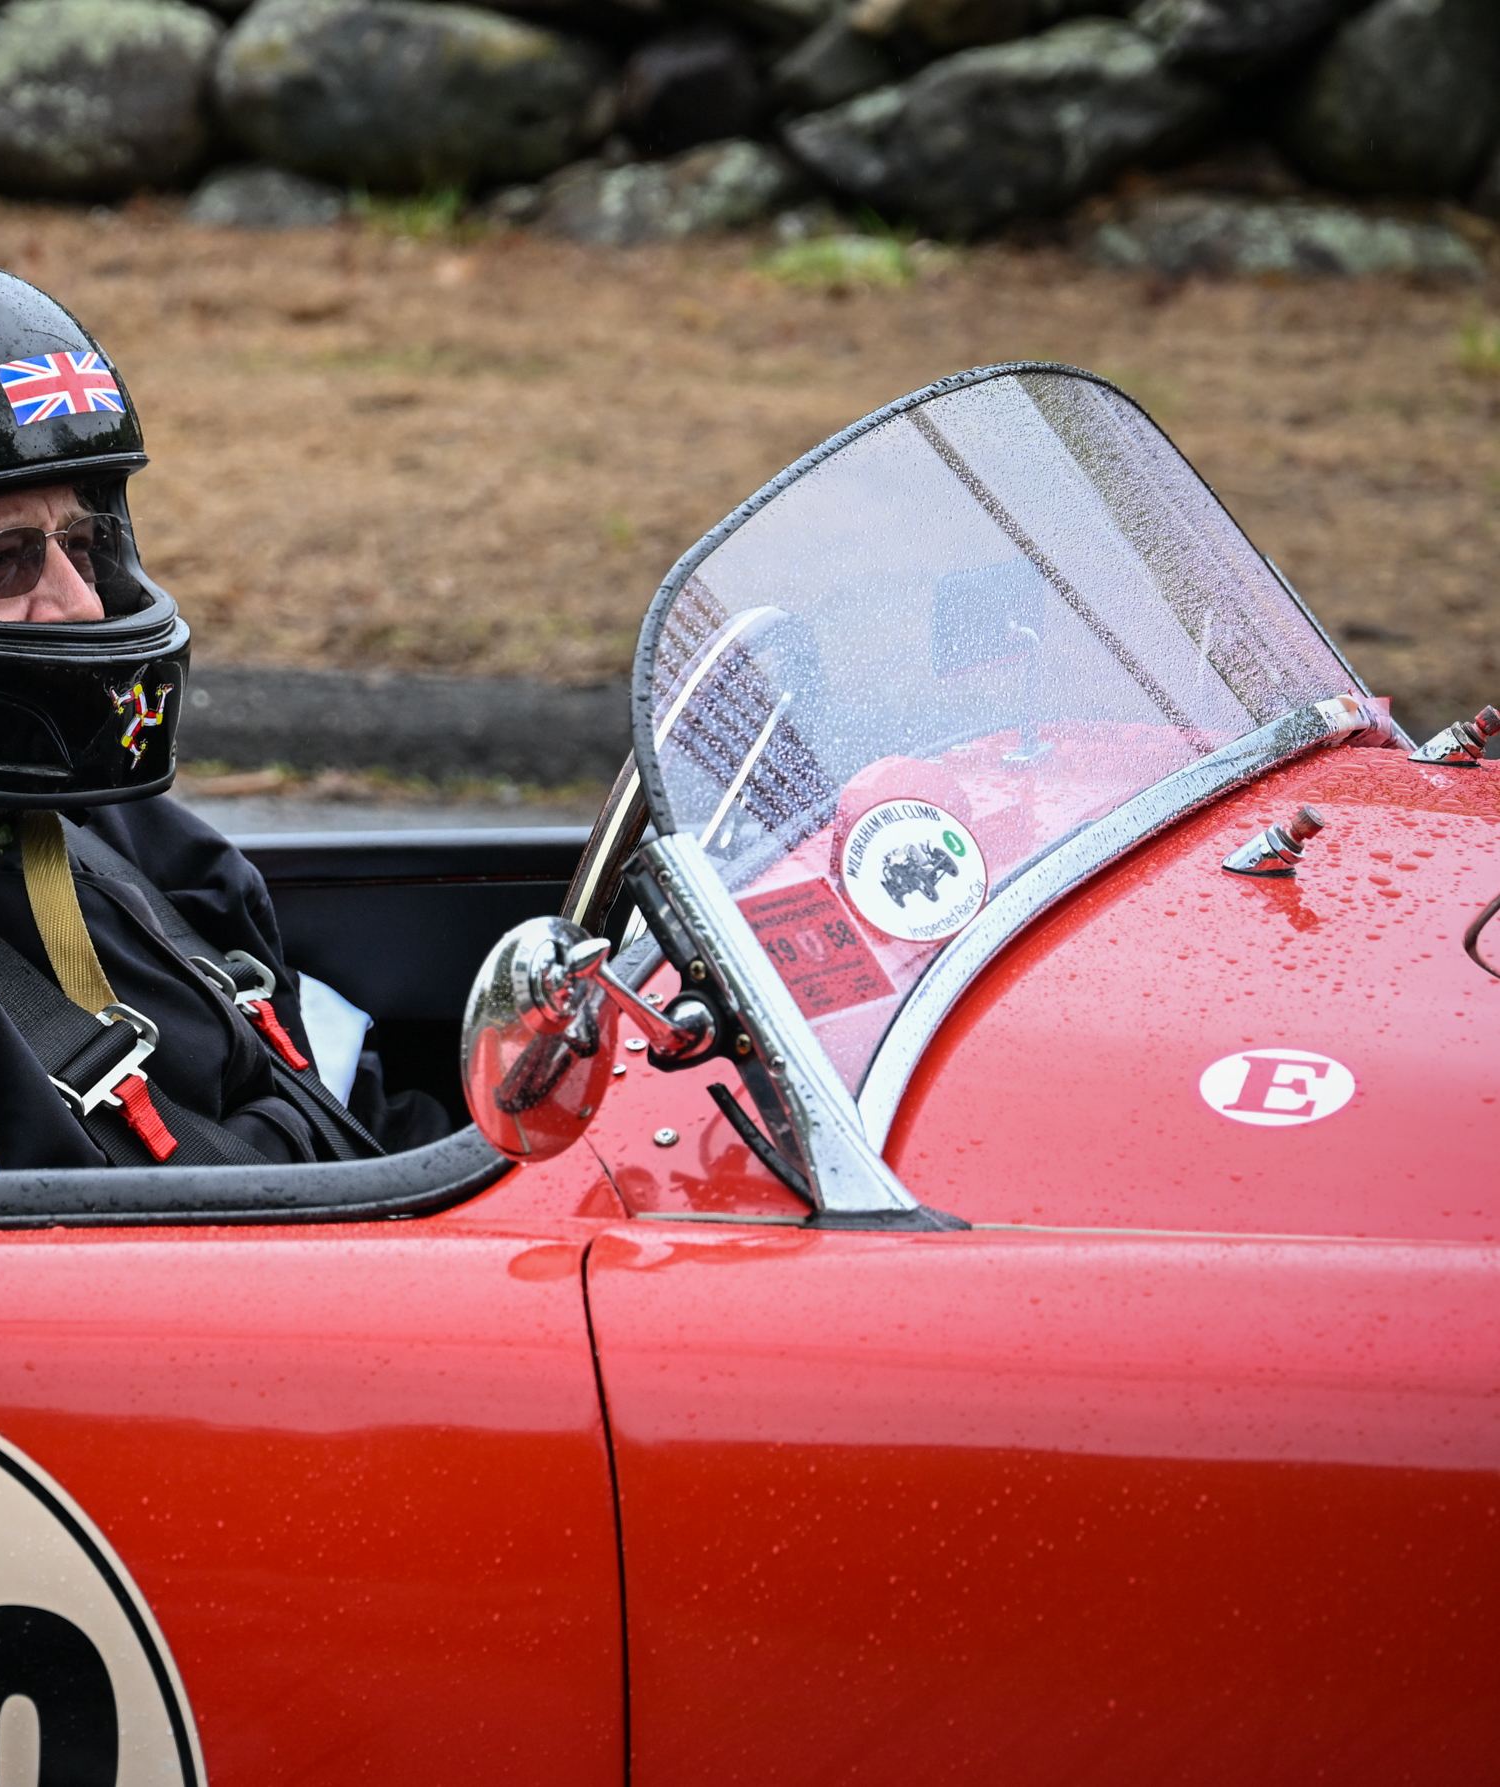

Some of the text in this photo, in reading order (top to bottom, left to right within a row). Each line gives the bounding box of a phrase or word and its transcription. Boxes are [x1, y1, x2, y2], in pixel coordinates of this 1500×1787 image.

[846, 804, 941, 879] WILBRAHAM HILL CLIMB
[908, 879, 987, 940] Inspected Race Car
[765, 937, 798, 966] 19
[1222, 1055, 1331, 1117] E
